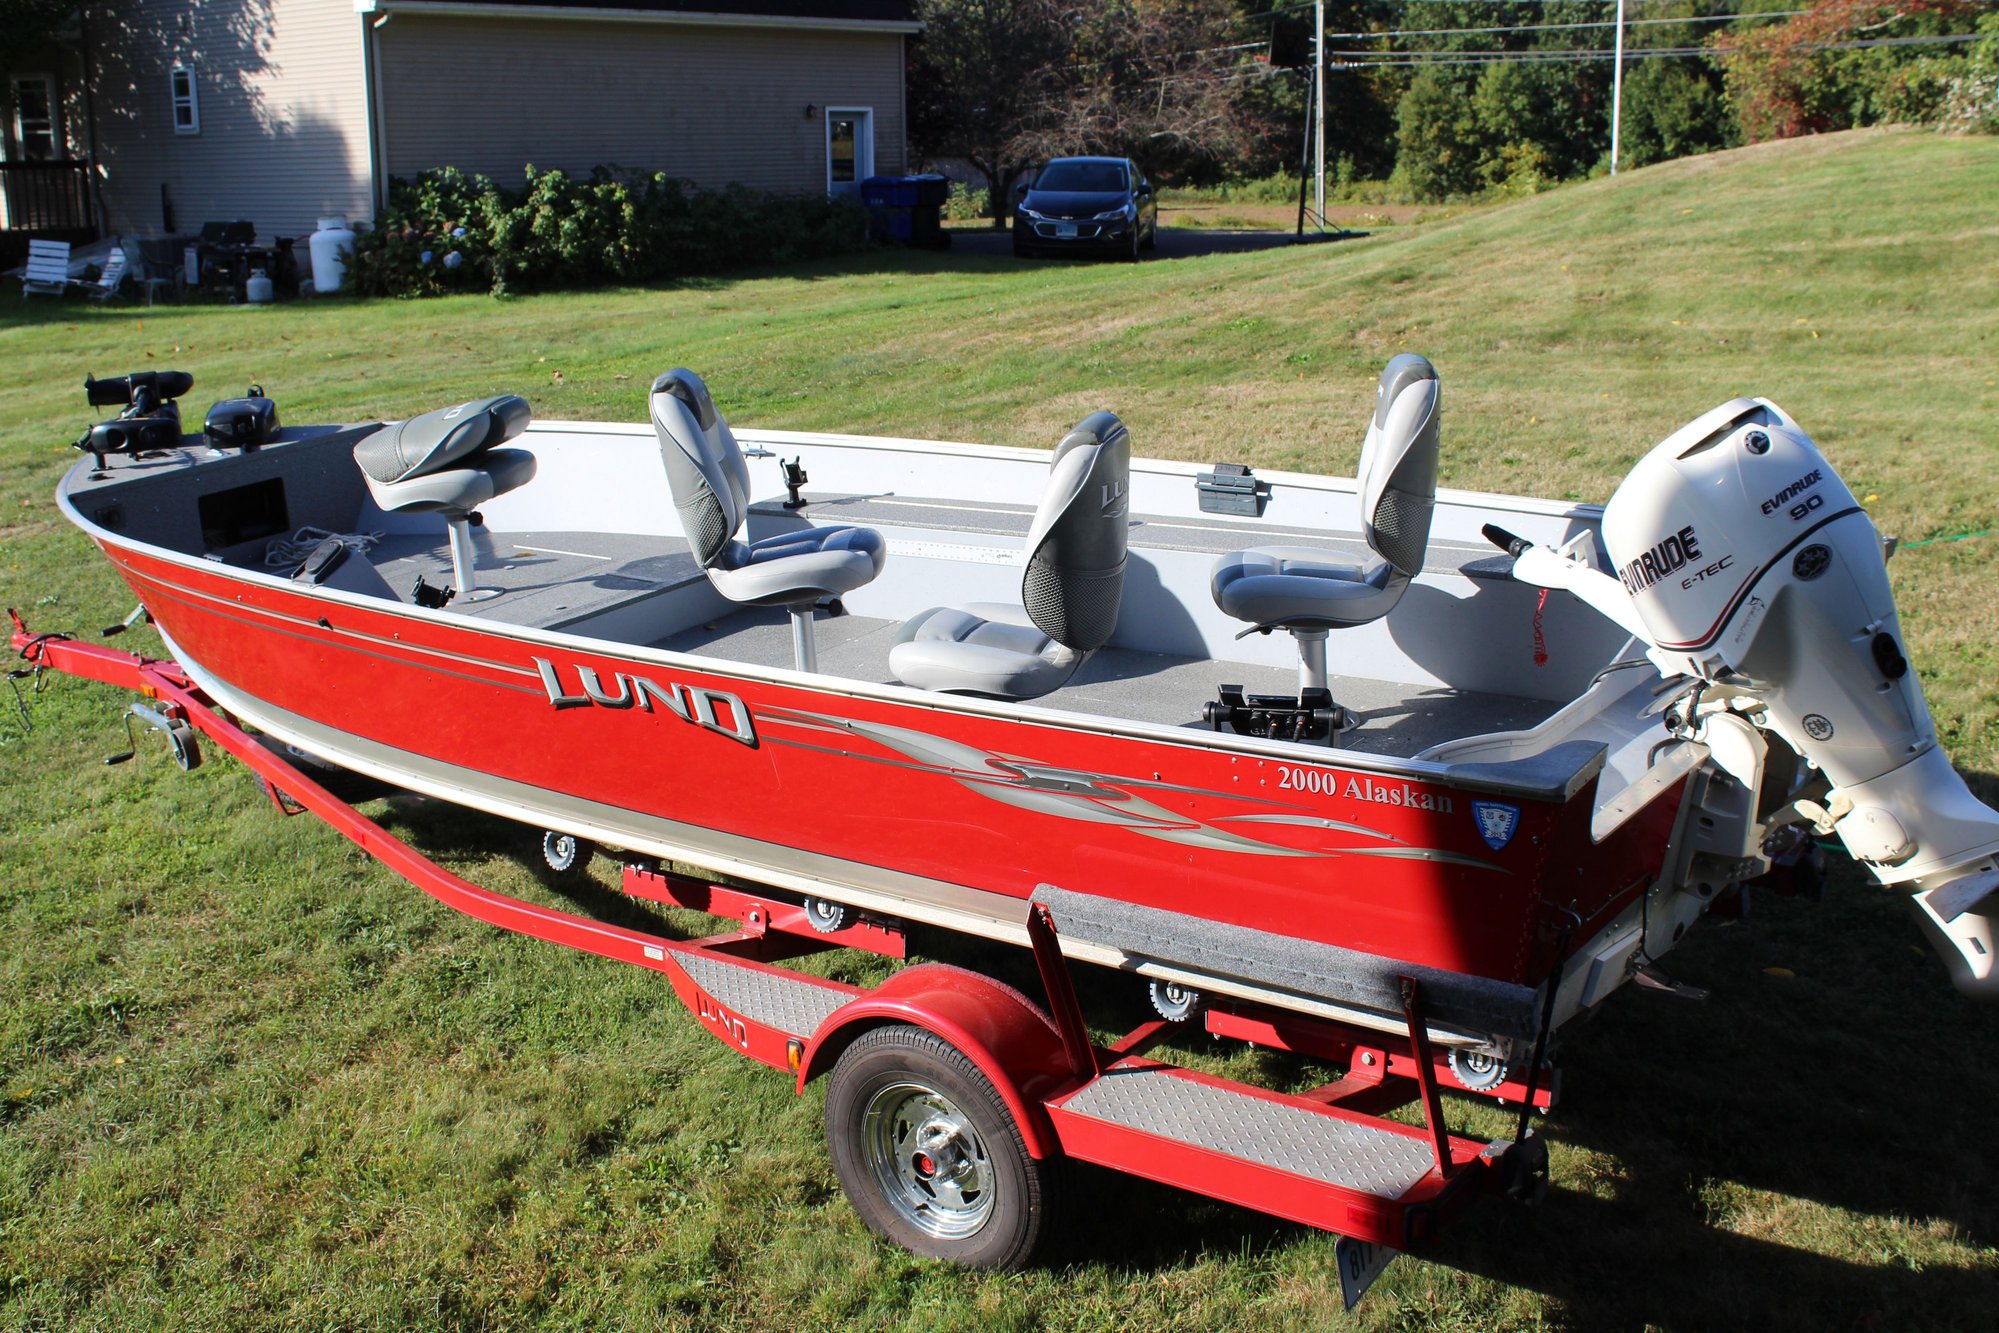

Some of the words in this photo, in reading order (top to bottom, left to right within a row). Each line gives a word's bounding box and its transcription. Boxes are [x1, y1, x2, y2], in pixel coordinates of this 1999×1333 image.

[1761, 469, 1822, 515] EVINRUDE
[1790, 494, 1824, 520] 90
[1619, 525, 1702, 598] EVINRUDE
[1681, 554, 1734, 590] E-TEC
[531, 656, 758, 748] LUND
[1278, 766, 1337, 796] 2000
[1343, 777, 1454, 814] Alaskan
[695, 991, 748, 1049] LUND
